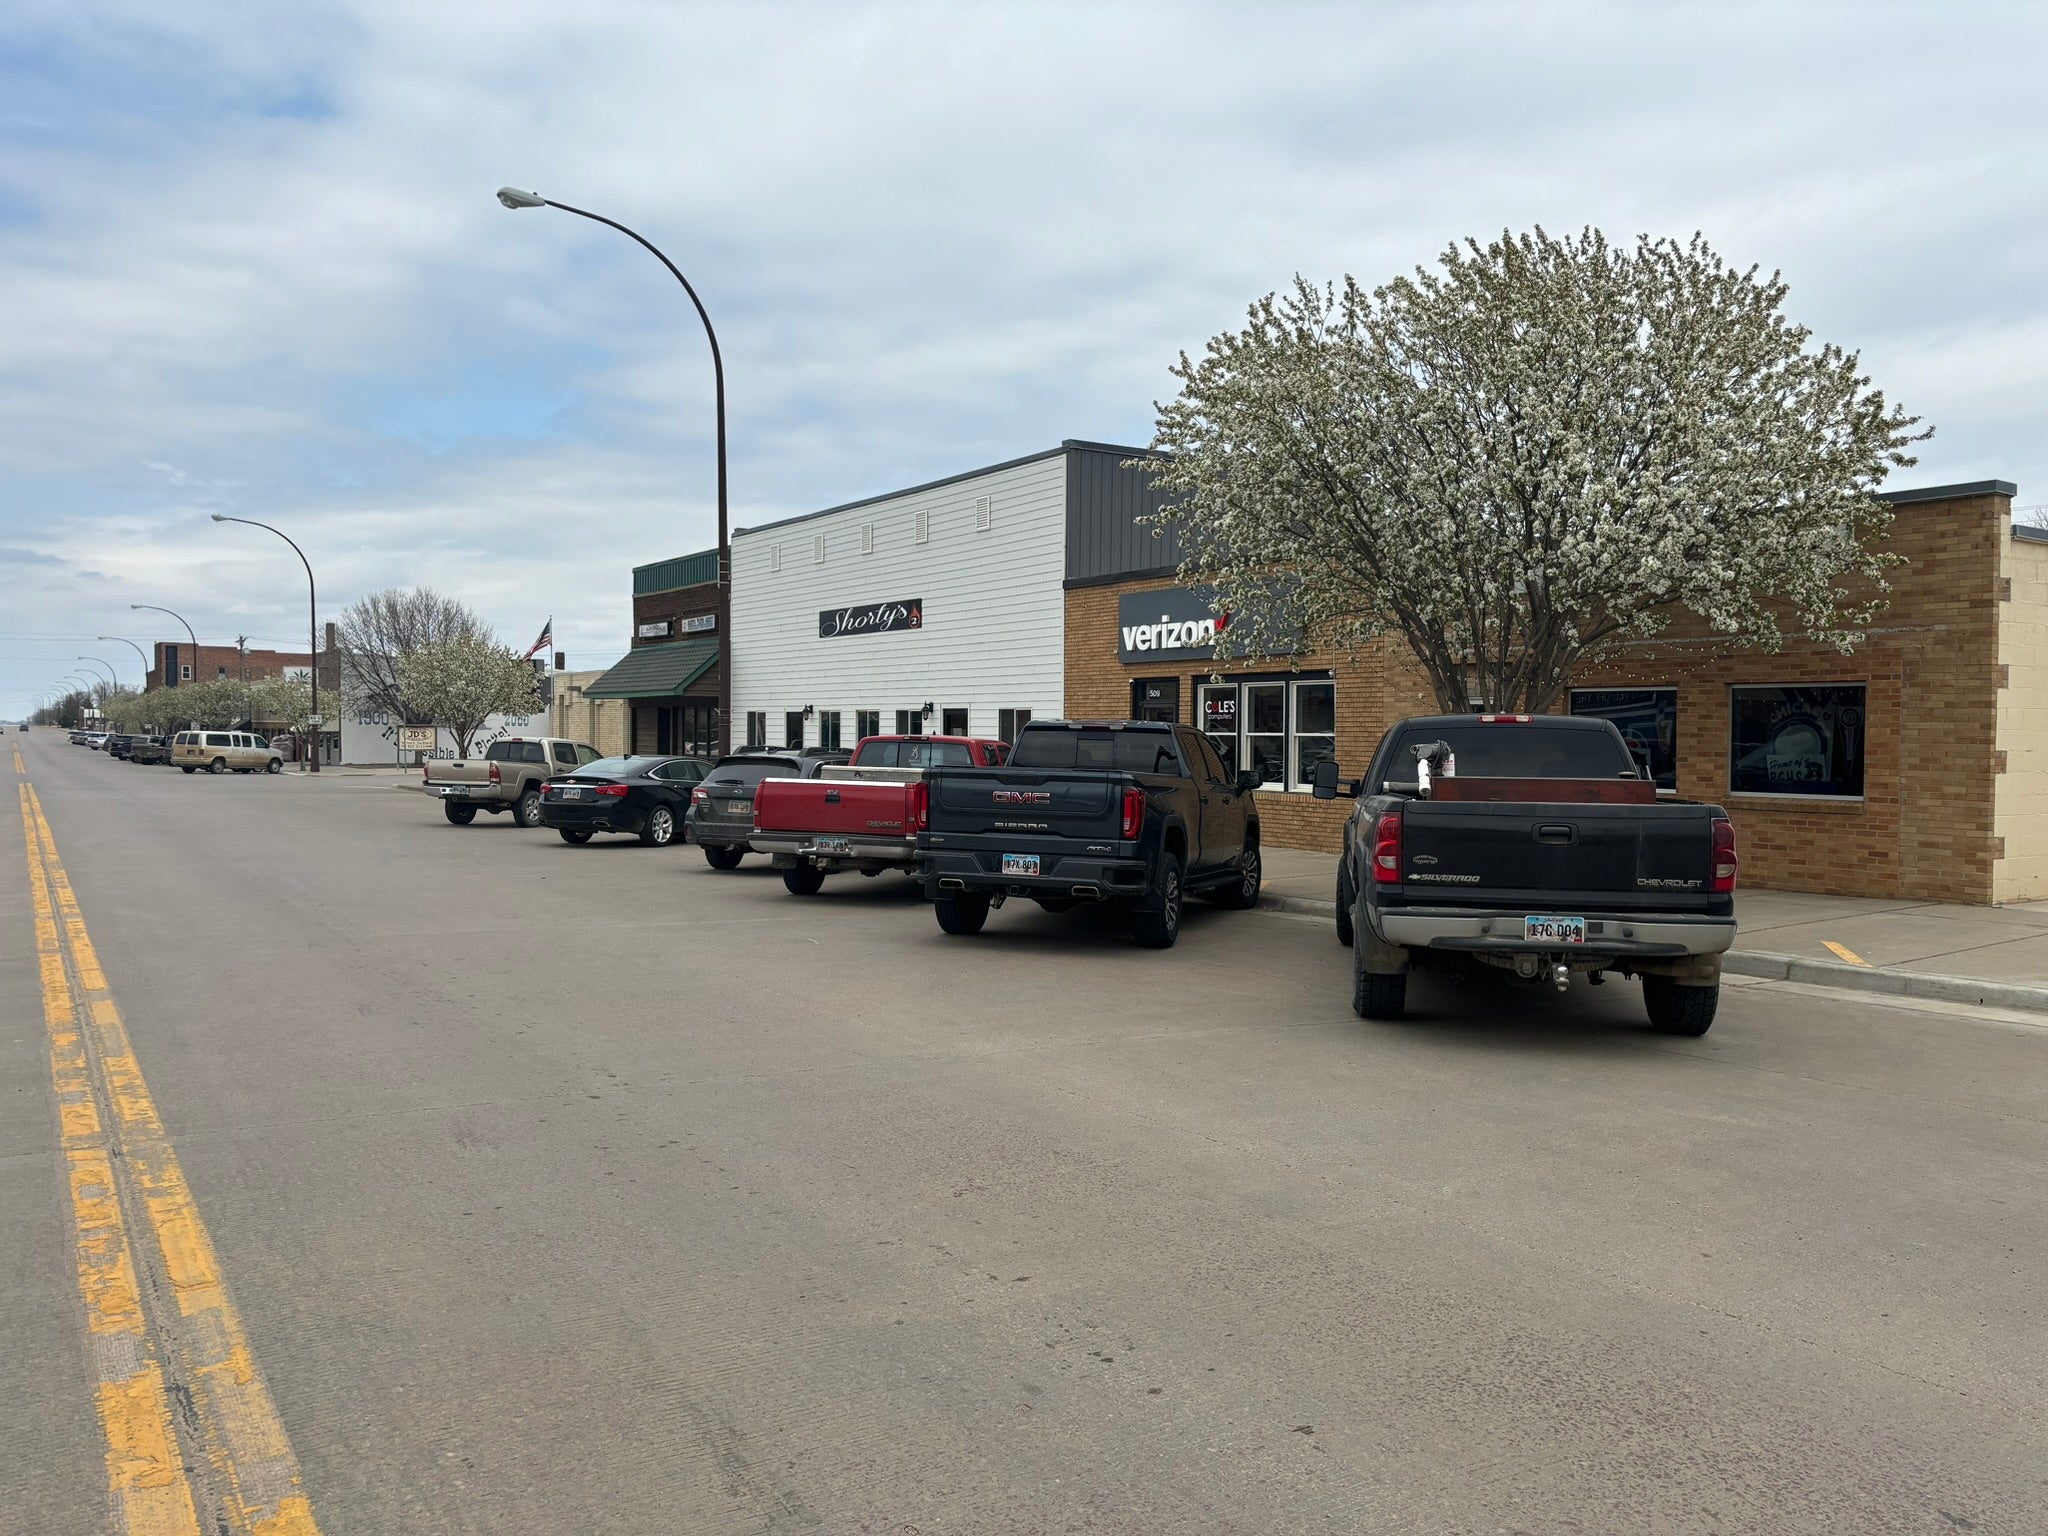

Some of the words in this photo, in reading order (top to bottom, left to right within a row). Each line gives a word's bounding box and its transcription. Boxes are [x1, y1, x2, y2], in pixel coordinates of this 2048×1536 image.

[821, 604, 908, 637] Shorty's
[911, 617, 918, 625] 2
[1122, 614, 1216, 651] verizon
[1150, 689, 1161, 698] 509
[1205, 700, 1235, 713] COLE'S
[407, 730, 427, 738] JD'S
[992, 790, 1051, 804] GMC
[994, 821, 1048, 829] SIERRA
[1420, 874, 1481, 883] SILVERADO
[1637, 878, 1702, 888] CHEVROLET
